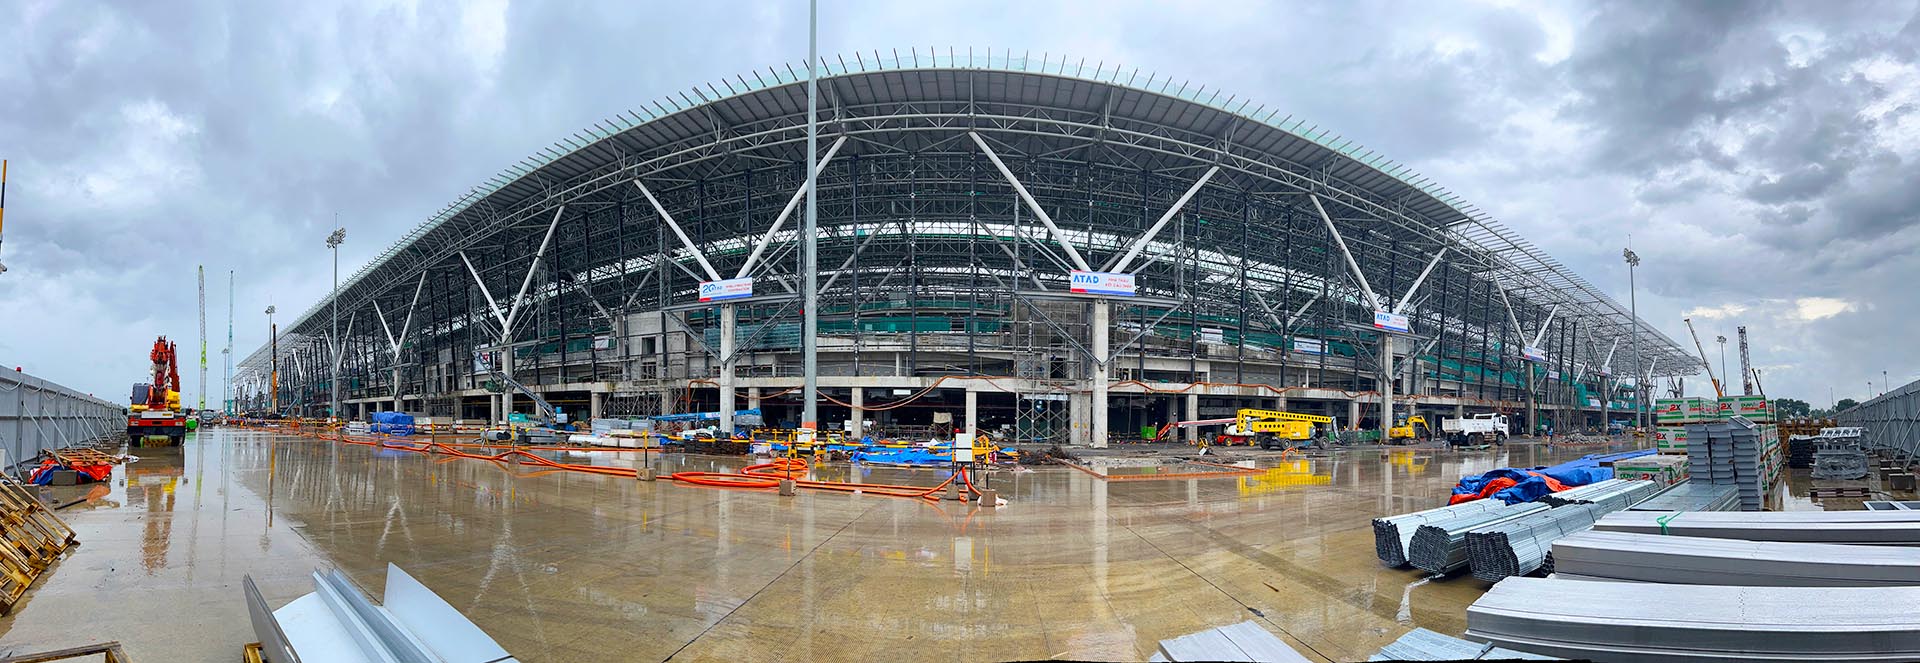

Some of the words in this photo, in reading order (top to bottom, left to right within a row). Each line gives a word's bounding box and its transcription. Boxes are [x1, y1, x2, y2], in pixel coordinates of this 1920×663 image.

[1073, 275, 1099, 284] ATAD
[1720, 402, 1732, 410] 2X
[1656, 432, 1667, 440] 2X
[1642, 473, 1656, 481] 2X
